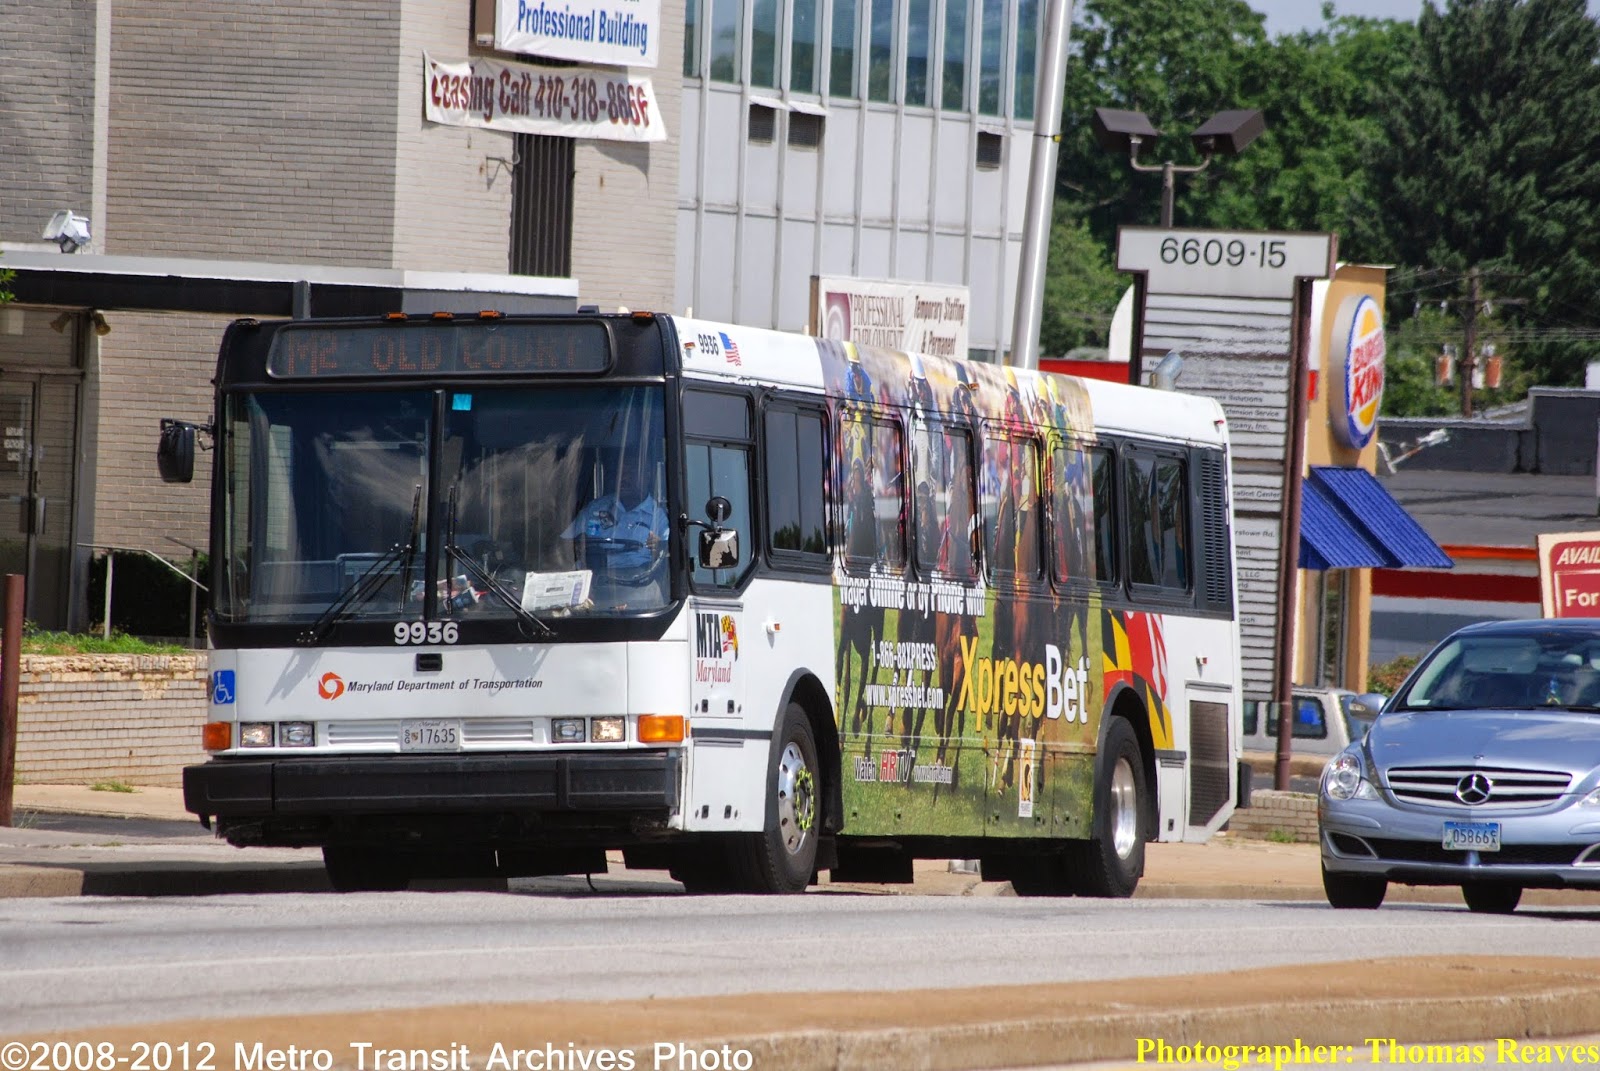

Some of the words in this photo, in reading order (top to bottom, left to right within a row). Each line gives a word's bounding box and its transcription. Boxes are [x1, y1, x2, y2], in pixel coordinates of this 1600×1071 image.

[518, 0, 595, 42] Professional
[600, 11, 648, 55] Building
[431, 63, 495, 123] Leasing
[500, 69, 531, 116] Call
[534, 75, 650, 128] 410-318-8666
[853, 293, 905, 327] PROFESSIONAL
[913, 295, 943, 324] Temporary
[944, 297, 966, 326] Staffing
[372, 334, 442, 371] OLD
[463, 332, 576, 369] COURT
[698, 333, 719, 356] 9936
[928, 330, 957, 355] Permanent
[1565, 587, 1600, 608] For
[394, 621, 459, 645] 9936
[696, 613, 722, 659] MTA
[871, 639, 937, 671] 1-866-88XPRESS
[347, 680, 394, 693] Maryland
[397, 679, 455, 693] Department
[459, 678, 471, 690] of
[473, 677, 543, 691] Transportation
[696, 660, 731, 688] Maryland
[957, 635, 1088, 733] XpressBet
[866, 681, 944, 714] www.xpressbet.com
[419, 728, 456, 745] 17635
[854, 756, 877, 782] Watch
[1453, 829, 1489, 844] 05866
